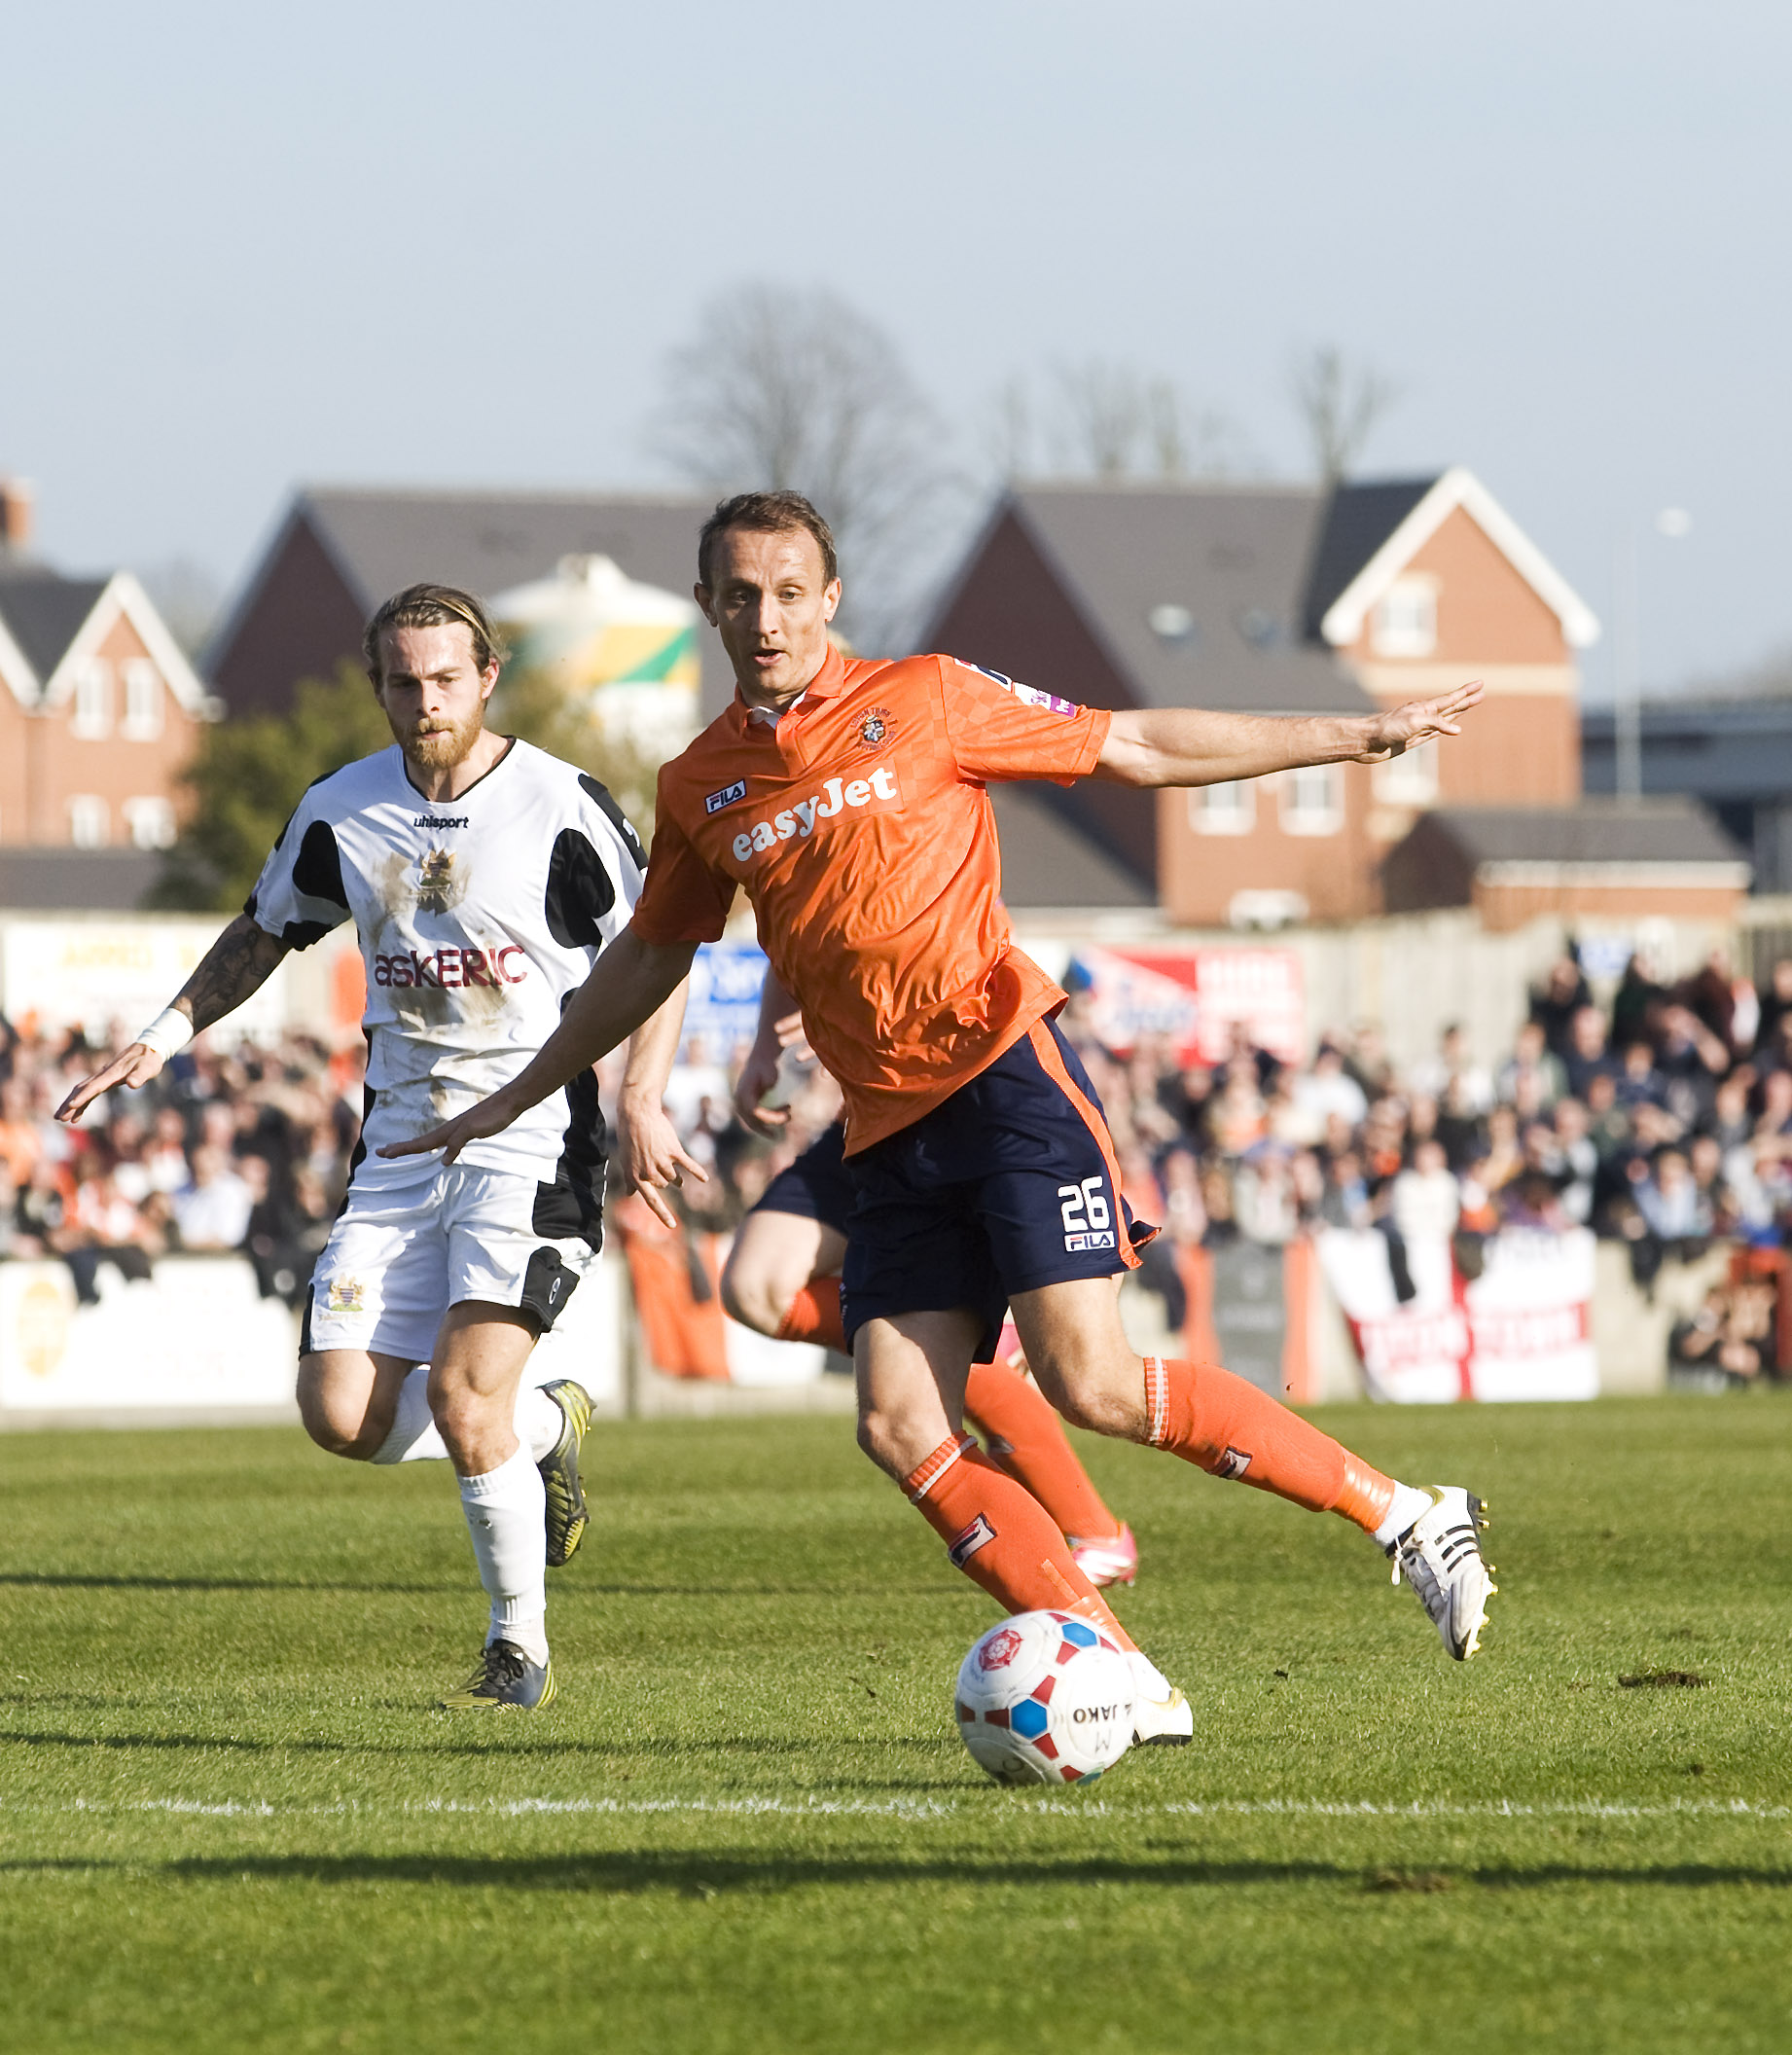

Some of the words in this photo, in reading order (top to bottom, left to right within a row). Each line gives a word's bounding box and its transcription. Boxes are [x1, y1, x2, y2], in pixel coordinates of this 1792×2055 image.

[709, 785, 742, 811] FILA
[413, 814, 469, 830] uhlsport
[733, 767, 897, 862] easyJet
[1057, 1175, 1110, 1233] 26
[1070, 1234, 1111, 1250] FILA
[1073, 1704, 1118, 1724] JAKO
